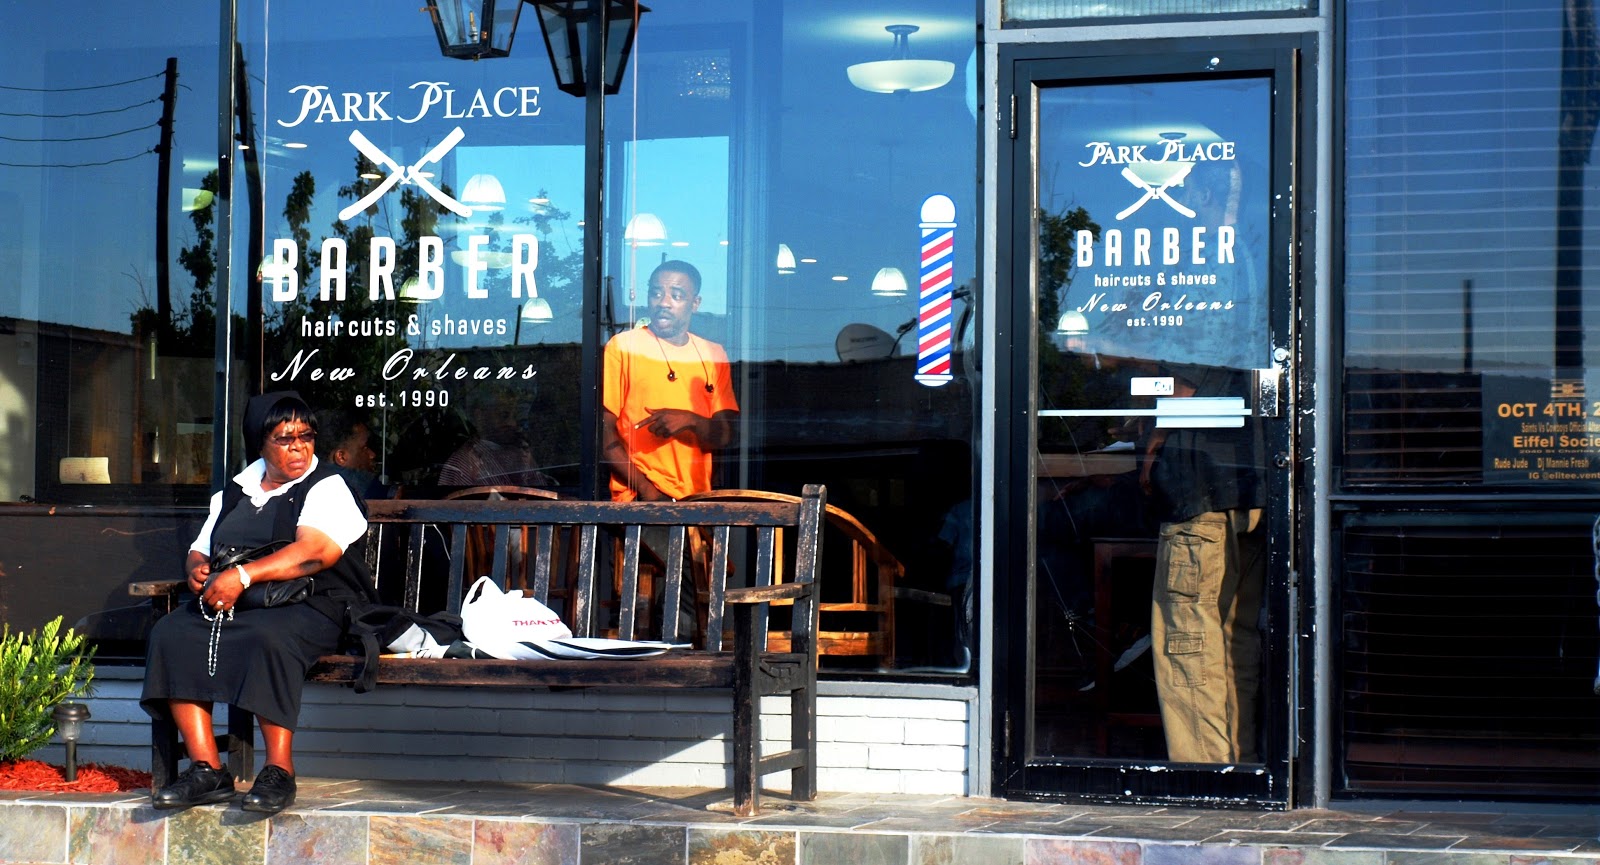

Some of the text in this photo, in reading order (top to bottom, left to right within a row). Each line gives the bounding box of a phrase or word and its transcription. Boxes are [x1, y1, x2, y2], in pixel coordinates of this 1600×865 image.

[277, 81, 541, 127] PARK PLACE
[1078, 139, 1236, 167] PARK PLACE
[1076, 225, 1235, 267] BARBER
[272, 233, 539, 302] BARBER
[1156, 272, 1166, 286] &
[1171, 272, 1217, 286] shaves
[1076, 291, 1235, 313] New Orleans
[407, 314, 421, 335] &
[431, 313, 507, 335] shaves
[1126, 315, 1184, 327] est.1990
[270, 348, 538, 382] New Orleans
[355, 390, 449, 407] est.1990
[1497, 403, 1538, 418] OCT
[1543, 403, 1587, 419] 4TH,
[1521, 422, 1537, 433] Saints
[1513, 435, 1555, 448] Eiffel
[1494, 458, 1529, 469] Rude Jude
[1546, 457, 1569, 469] Mannie
[1570, 457, 1590, 469] Fresh
[1529, 472, 1540, 480] IG
